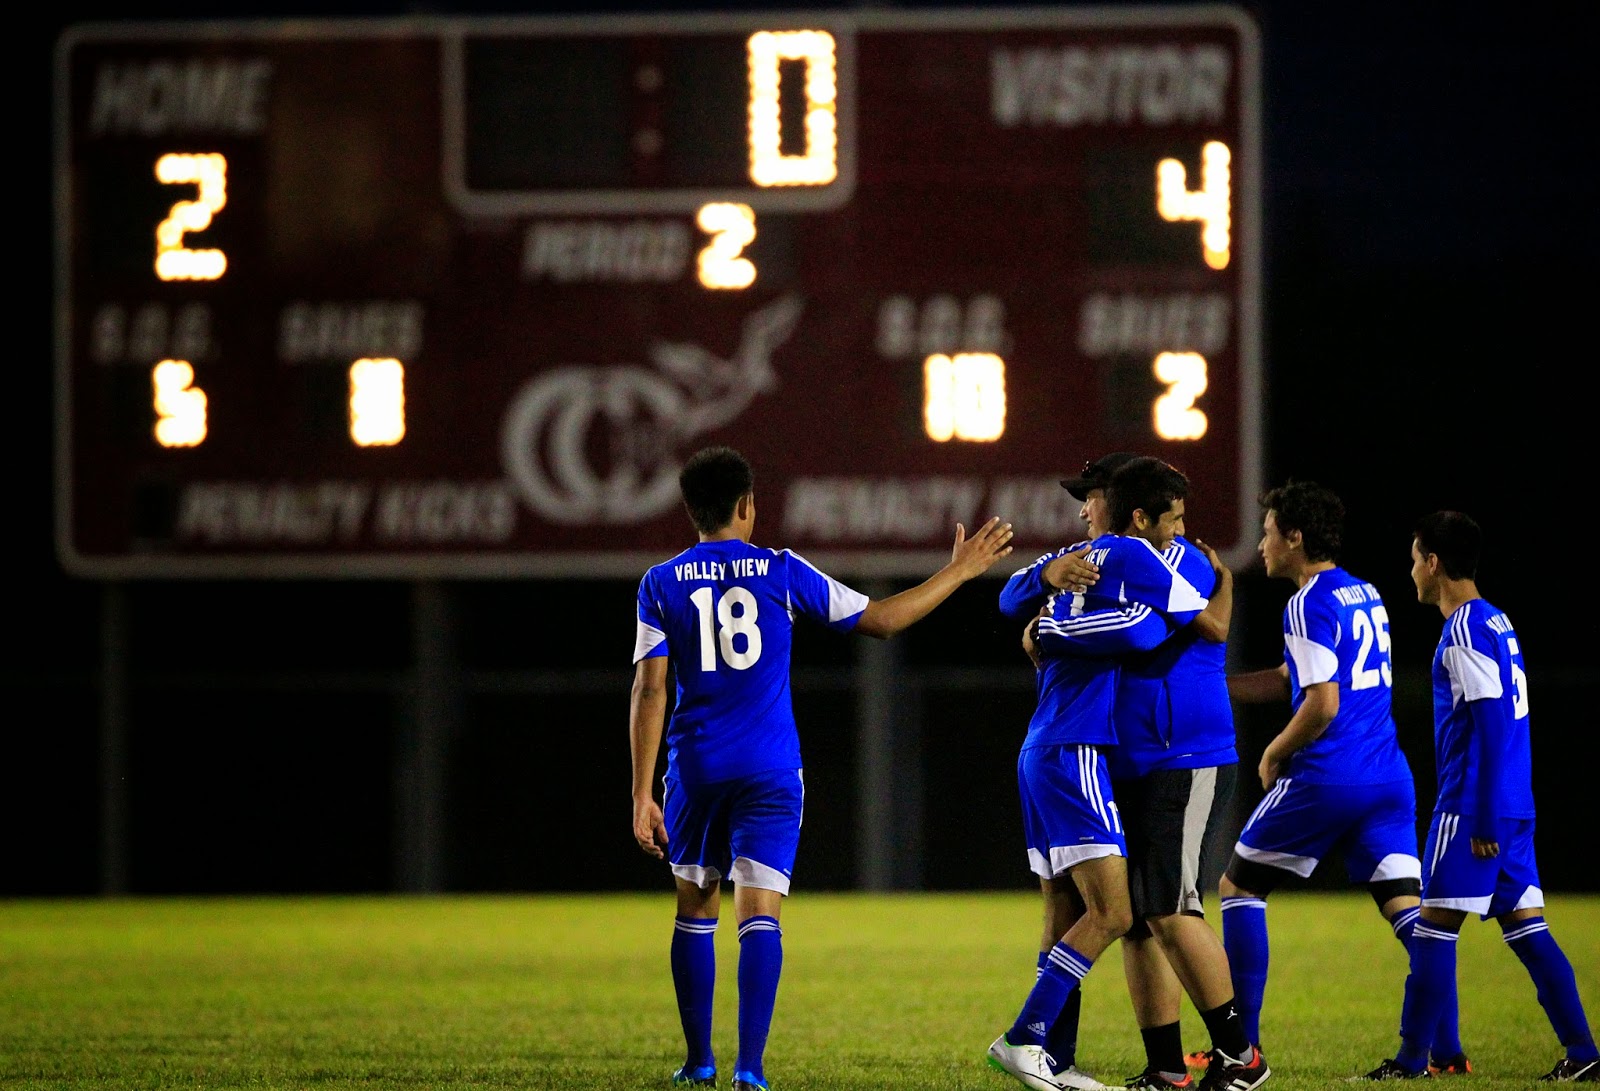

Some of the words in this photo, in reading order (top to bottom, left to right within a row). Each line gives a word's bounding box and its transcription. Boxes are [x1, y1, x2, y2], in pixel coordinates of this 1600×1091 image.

[92, 60, 272, 134] HOME
[747, 29, 838, 188] 0
[991, 46, 1230, 126] VISITOR
[155, 153, 227, 281] 2
[522, 220, 688, 282] PERIOD
[696, 201, 757, 290] 2
[1157, 141, 1231, 269] 4
[153, 359, 207, 447] 5
[923, 351, 1007, 443] 10
[1153, 351, 1208, 441] 2
[179, 480, 373, 542] PENALTY
[375, 480, 516, 541] KICKS
[784, 475, 986, 540] PENALTY
[674, 562, 726, 582] VALLEY
[732, 558, 769, 578] VIEW
[690, 586, 762, 672] 18
[1351, 605, 1393, 690] 25
[1506, 637, 1529, 720] 5
